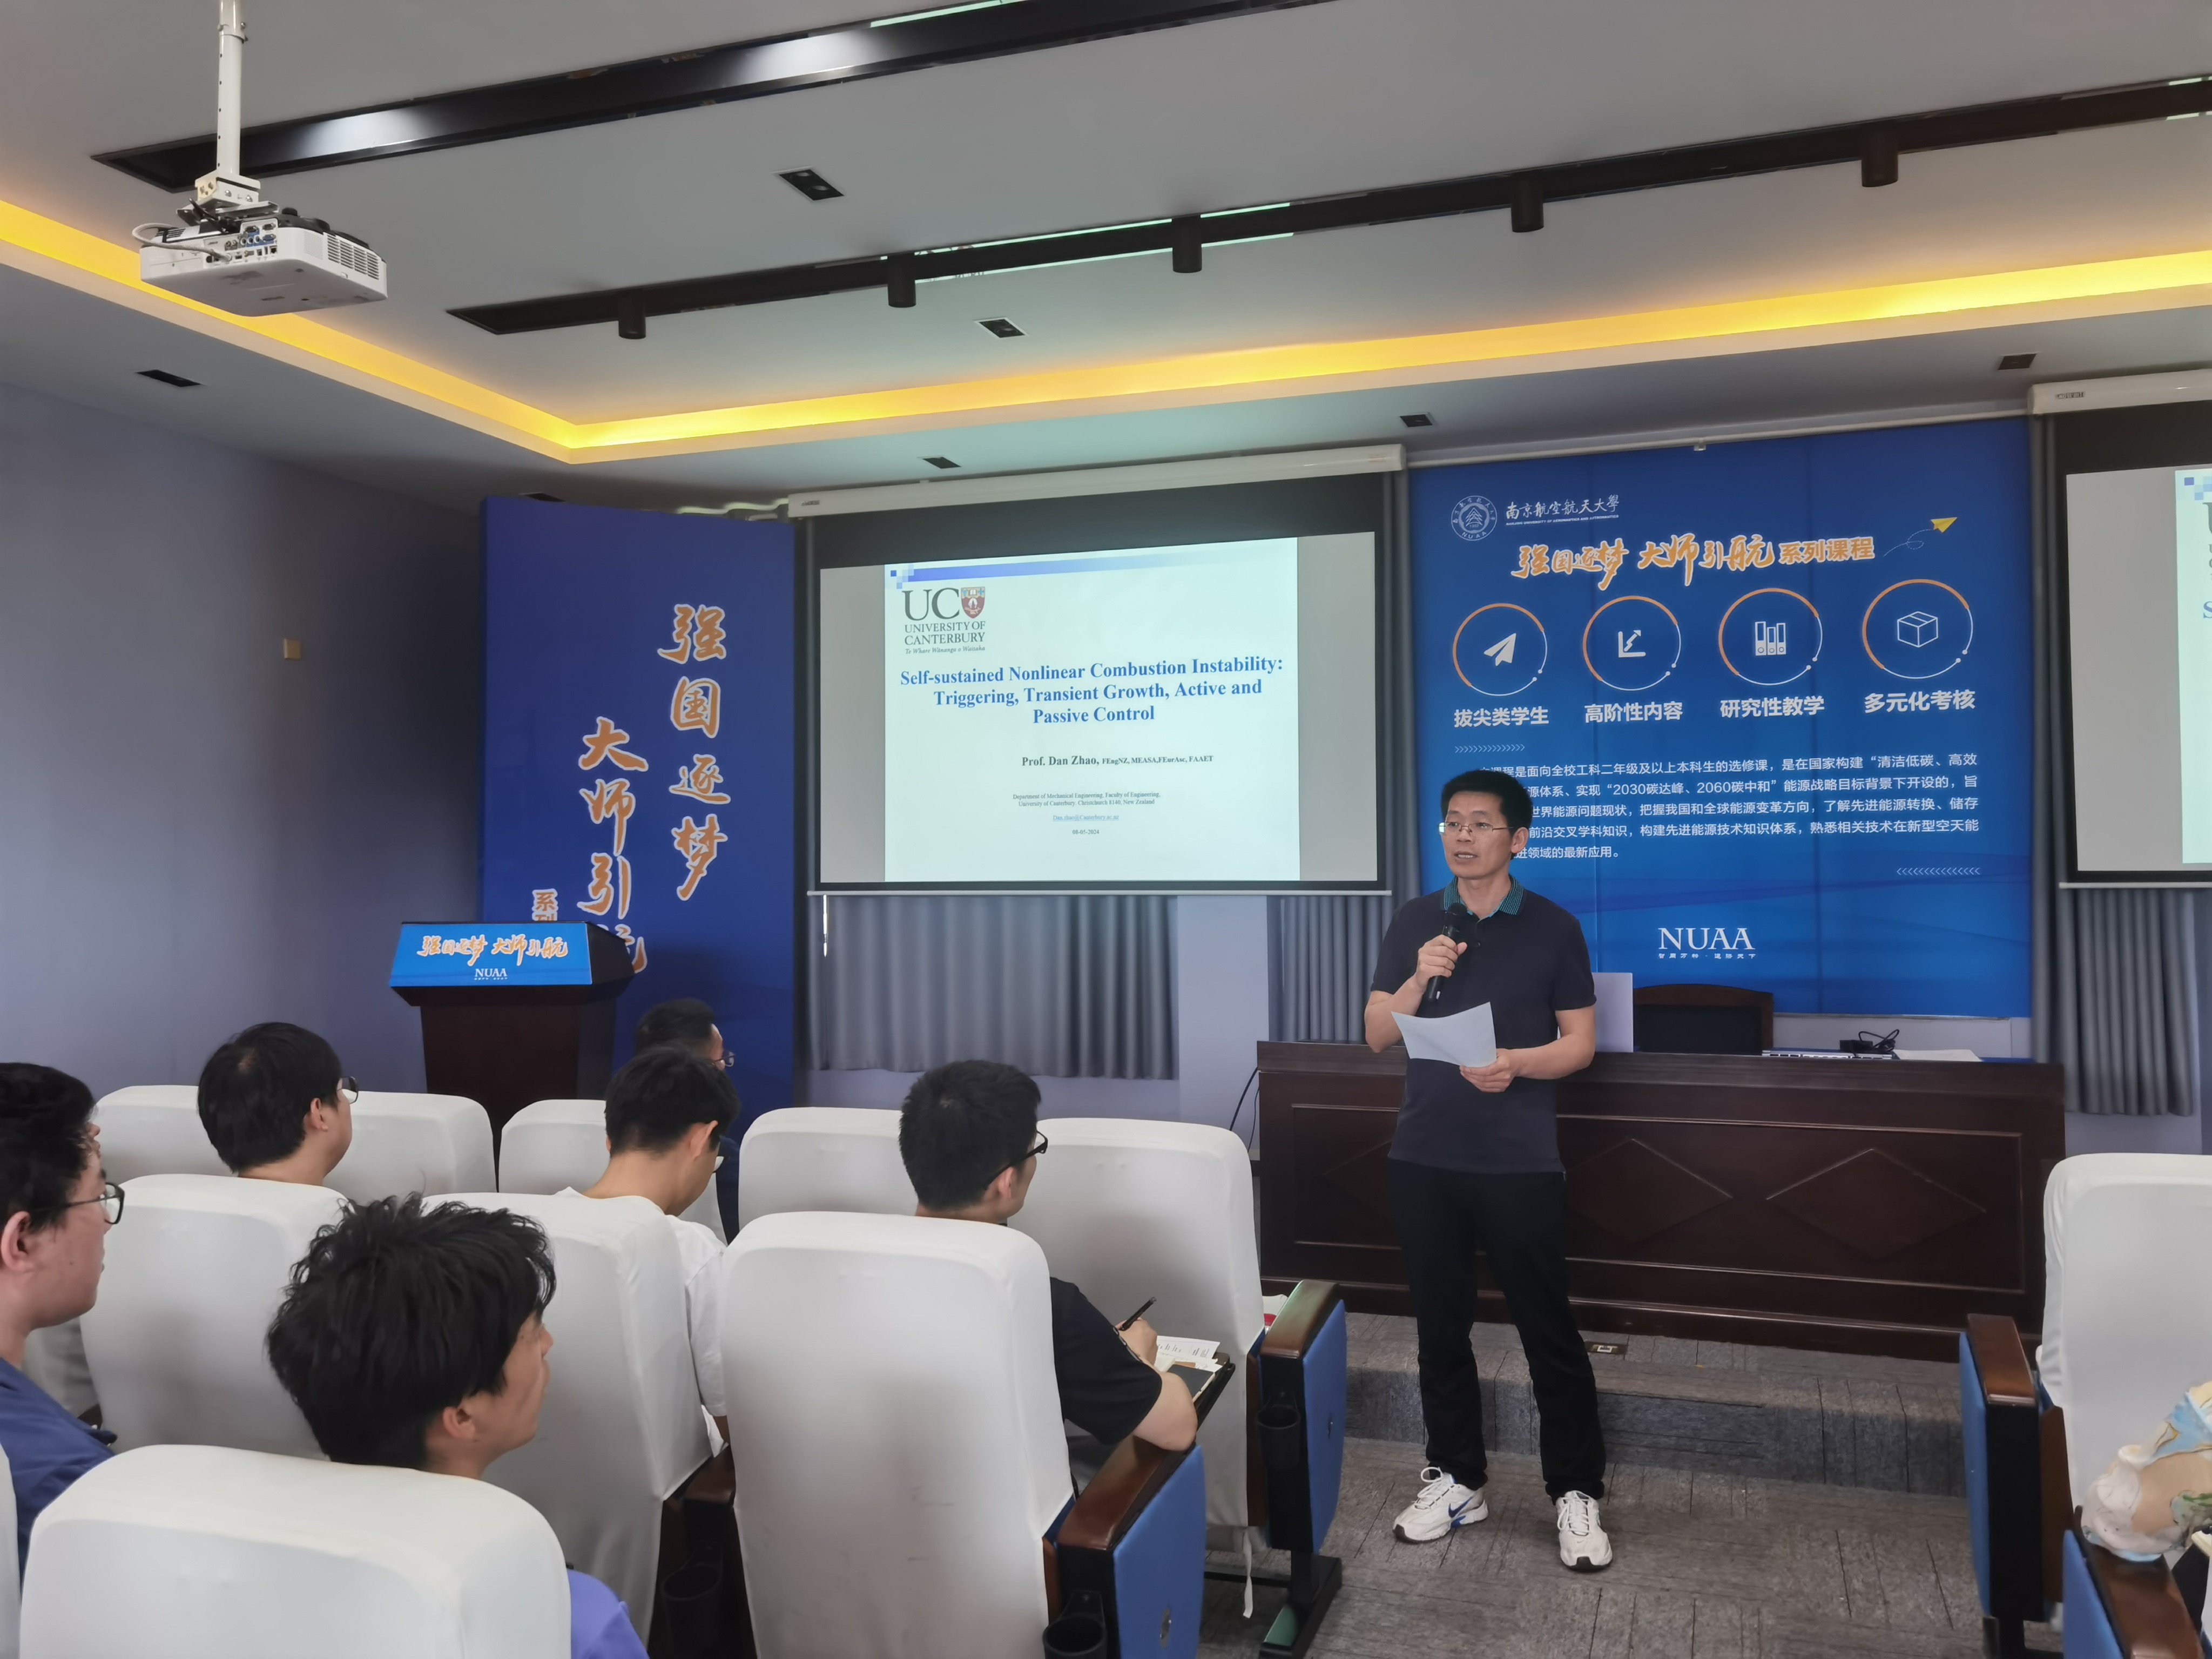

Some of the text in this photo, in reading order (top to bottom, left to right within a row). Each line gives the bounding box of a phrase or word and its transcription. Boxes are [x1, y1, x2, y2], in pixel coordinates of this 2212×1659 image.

[1511, 532, 1875, 590] 强国逐梦 大师引航 系列课程
[902, 588, 960, 621] UC
[905, 621, 986, 633] UNIVERSITY OF
[905, 632, 986, 645] CANTERBURY
[901, 656, 1283, 685] Self-sustained Nonlinear Combustion Instability:
[933, 679, 1263, 708] Triggering, Transient Growth, Active and
[1033, 705, 1155, 724] Passive Control
[1454, 689, 1975, 727] 拔尖类学生 高阶性内容 研究性教学 多元化考核
[657, 599, 731, 901] 强国逐梦
[1022, 756, 1046, 766] Prof.
[1049, 756, 1068, 766] Dan
[1071, 755, 1100, 766] Zhao,
[1480, 753, 1977, 778] 程是面向全校工科二年级及以上本科生的选修课，是在国家构建“清洁低碳、高效
[1523, 775, 1978, 798] 源体系、实现“2030碳达峰、2060碳中和”能源战略目标背景下开设的，旨
[416, 933, 569, 967] 强国逐梦 大师引航
[1658, 927, 1756, 950] NUAA
[474, 968, 508, 977] NUAA
